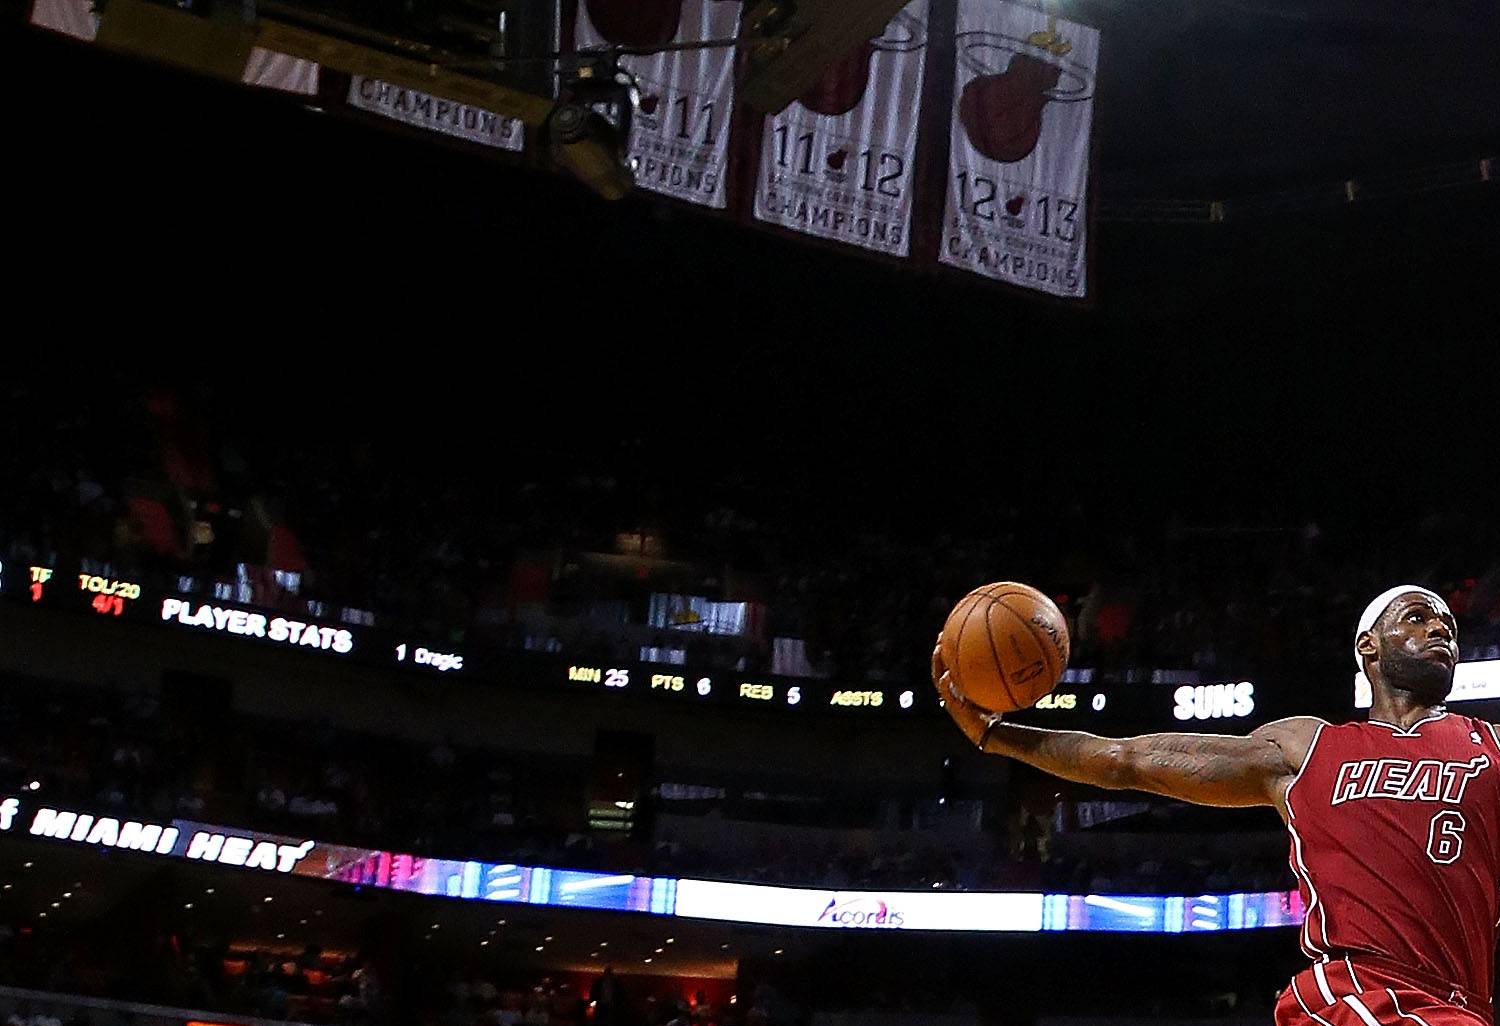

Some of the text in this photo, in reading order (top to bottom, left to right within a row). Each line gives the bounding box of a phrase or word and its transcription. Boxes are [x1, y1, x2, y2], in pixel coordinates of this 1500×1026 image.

[774, 125, 816, 174] 11
[860, 149, 904, 197] 12
[956, 171, 997, 221] 12
[1037, 196, 1078, 242] 13
[162, 598, 266, 638] PLAYER
[268, 617, 353, 653] STATS
[604, 668, 629, 688] 25
[651, 674, 685, 692] PTS
[739, 683, 774, 701] REB
[1173, 681, 1255, 720] SUNS
[1331, 754, 1490, 806] HEAT
[29, 807, 180, 855] MIAMI
[186, 831, 315, 873] HEAT
[1426, 809, 1466, 864] 6
